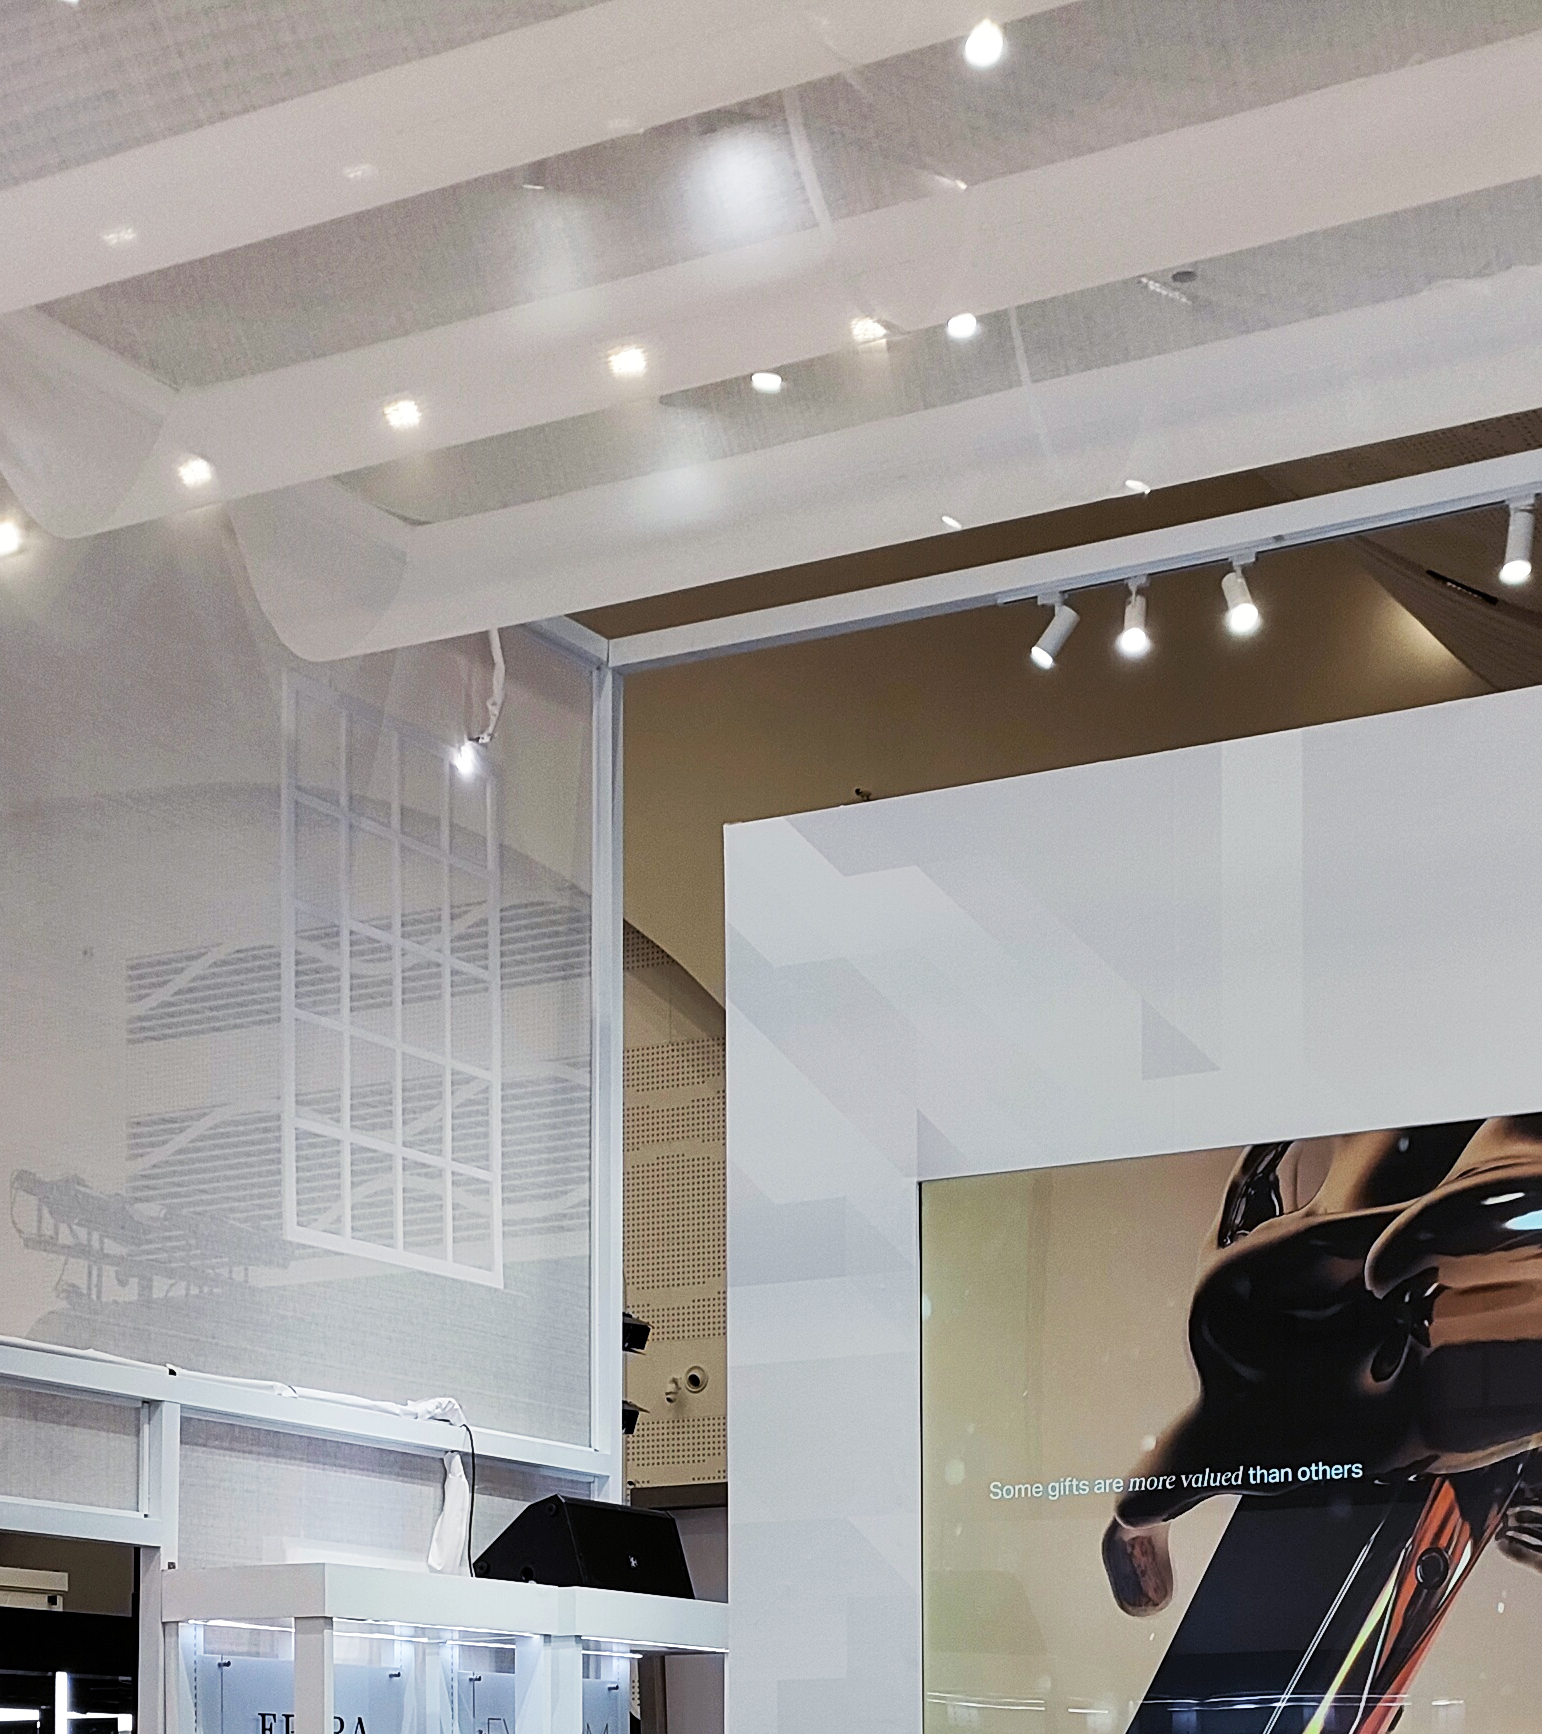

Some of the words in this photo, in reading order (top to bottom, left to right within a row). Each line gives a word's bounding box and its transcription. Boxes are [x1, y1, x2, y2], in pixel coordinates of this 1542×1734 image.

[989, 1481, 1043, 1500] Some
[1047, 1477, 1091, 1501] gifts
[1093, 1476, 1125, 1494] are
[1128, 1473, 1176, 1492] more
[1180, 1466, 1245, 1488] valued
[1247, 1464, 1294, 1485] than
[1297, 1461, 1364, 1482] others
